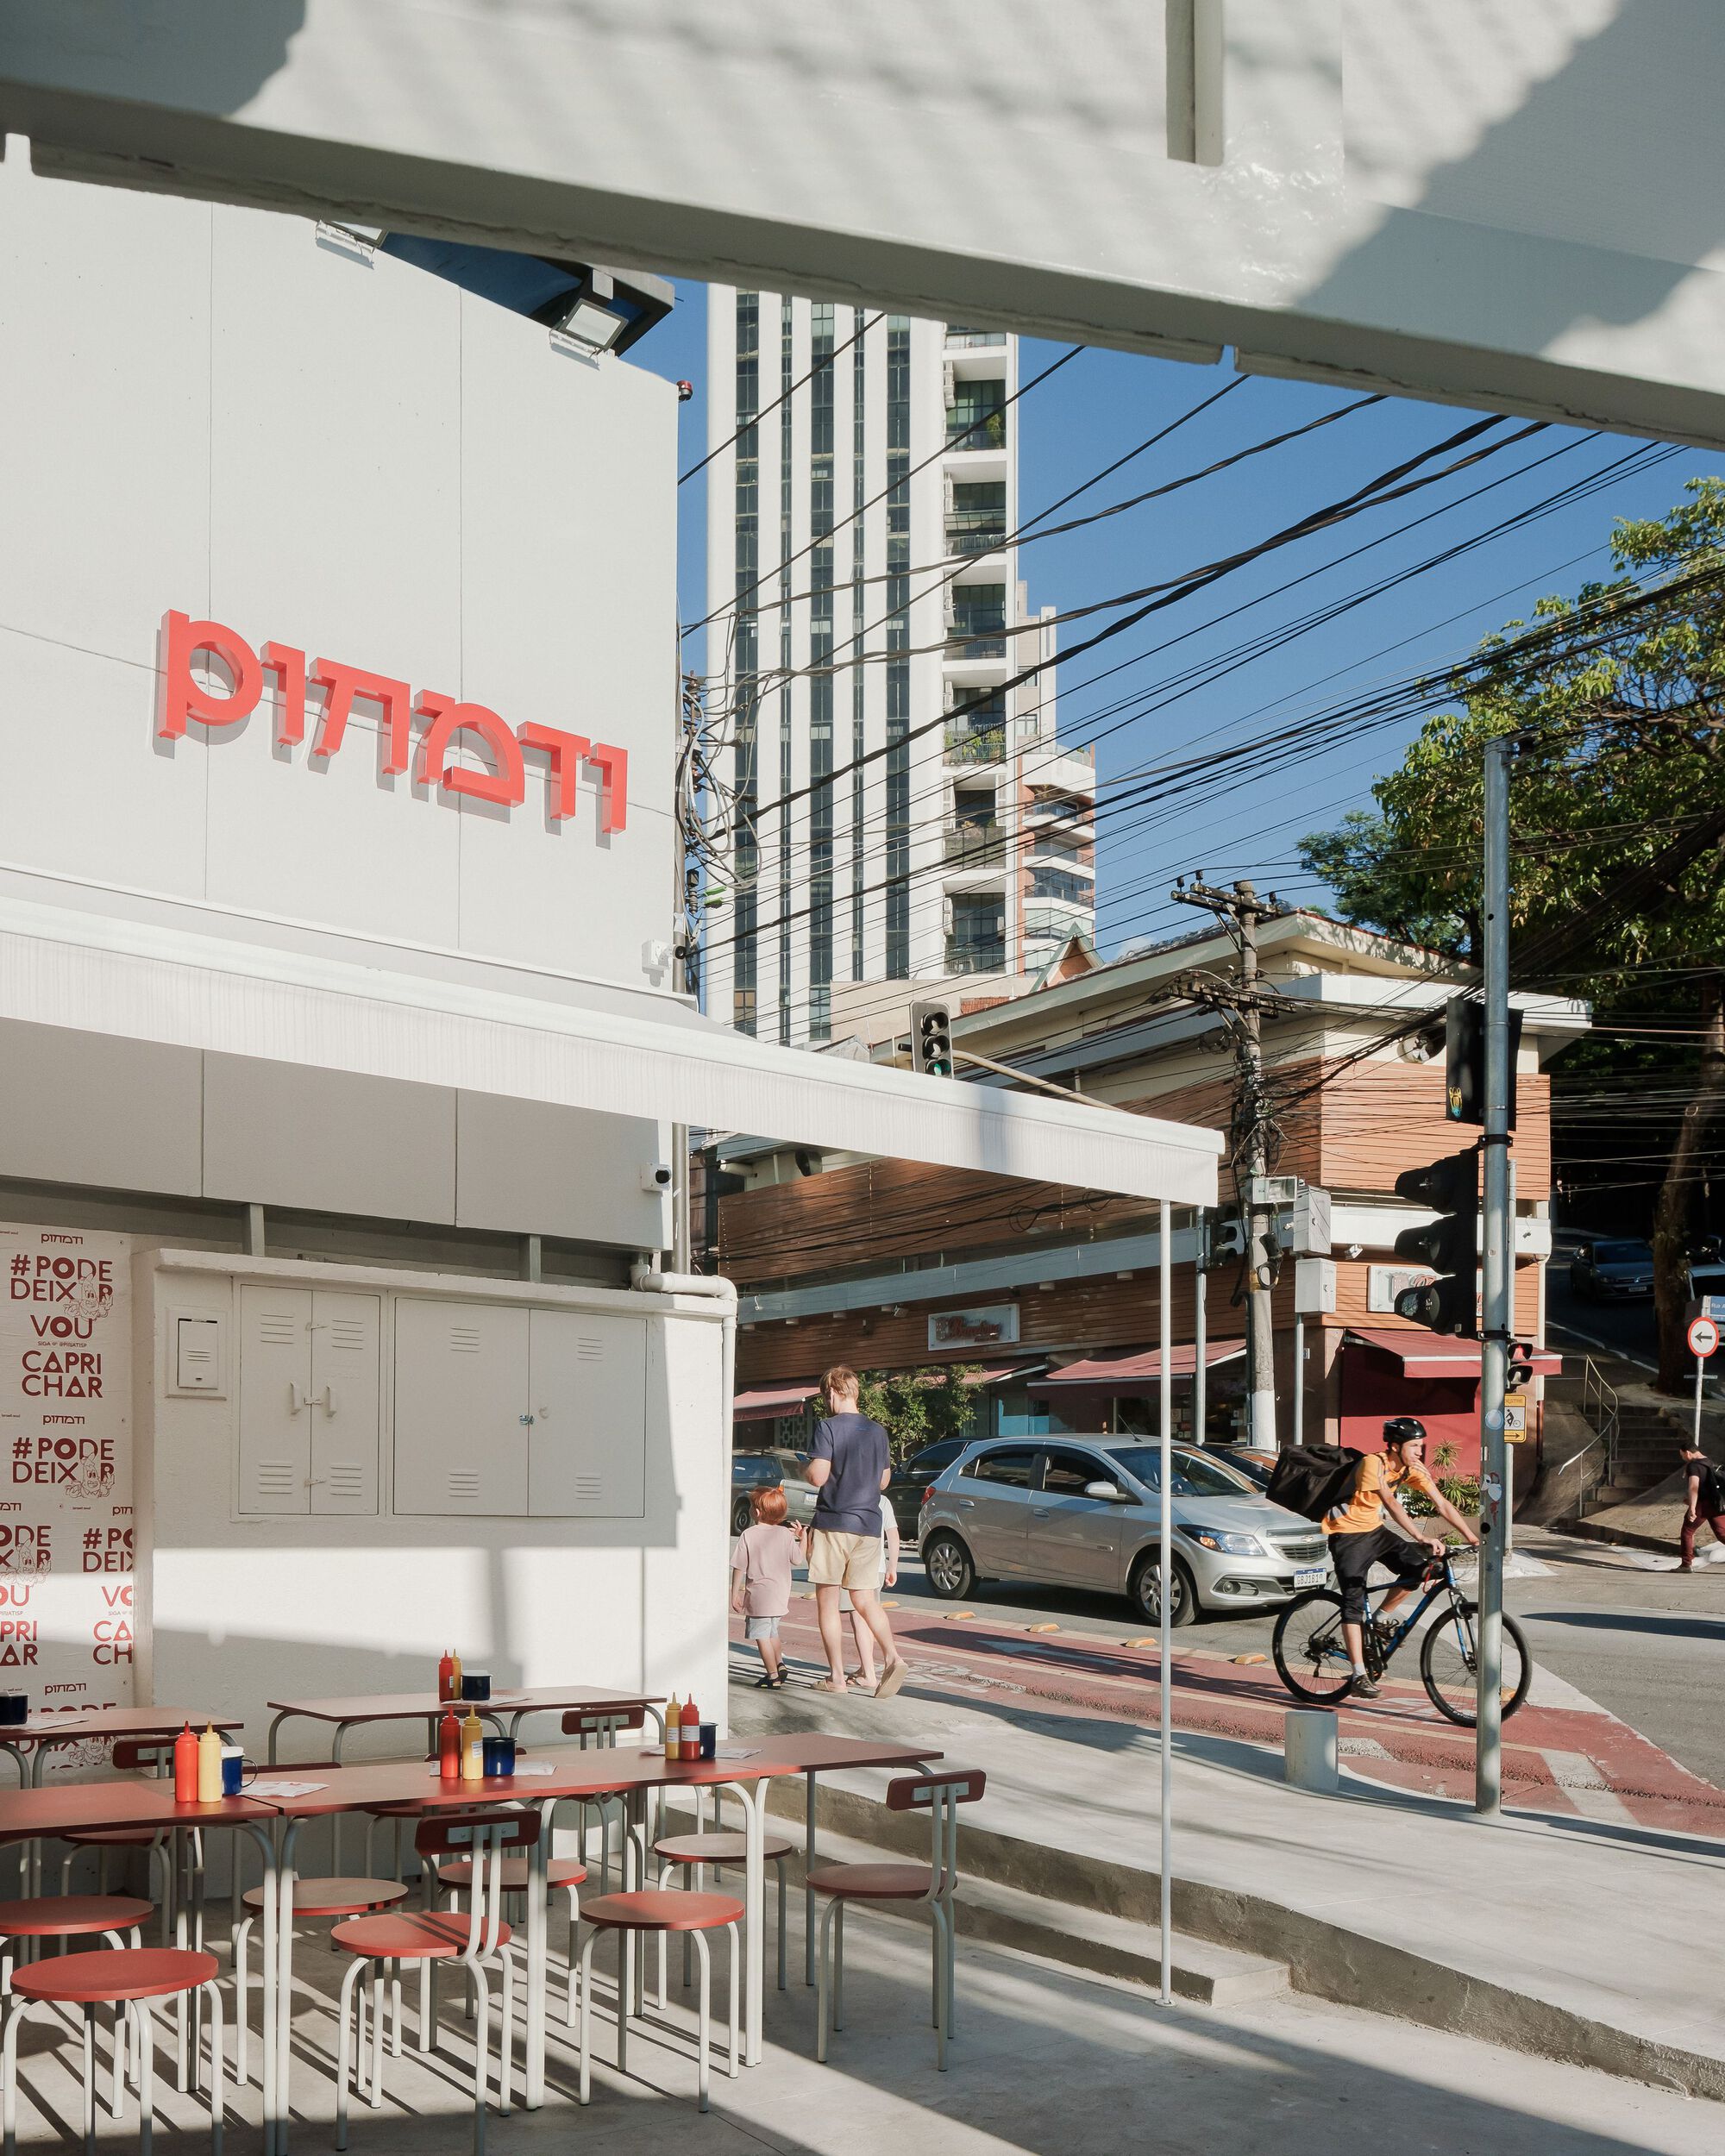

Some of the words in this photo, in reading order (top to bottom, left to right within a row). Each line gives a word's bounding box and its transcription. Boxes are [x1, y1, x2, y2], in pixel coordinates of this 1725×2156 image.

[10, 1277, 113, 1302] DEIXR
[30, 1313, 93, 1339] VOU
[22, 1350, 102, 1375] CAPRI
[22, 1374, 103, 1398] CHAR
[12, 1461, 115, 1483] DEIXR
